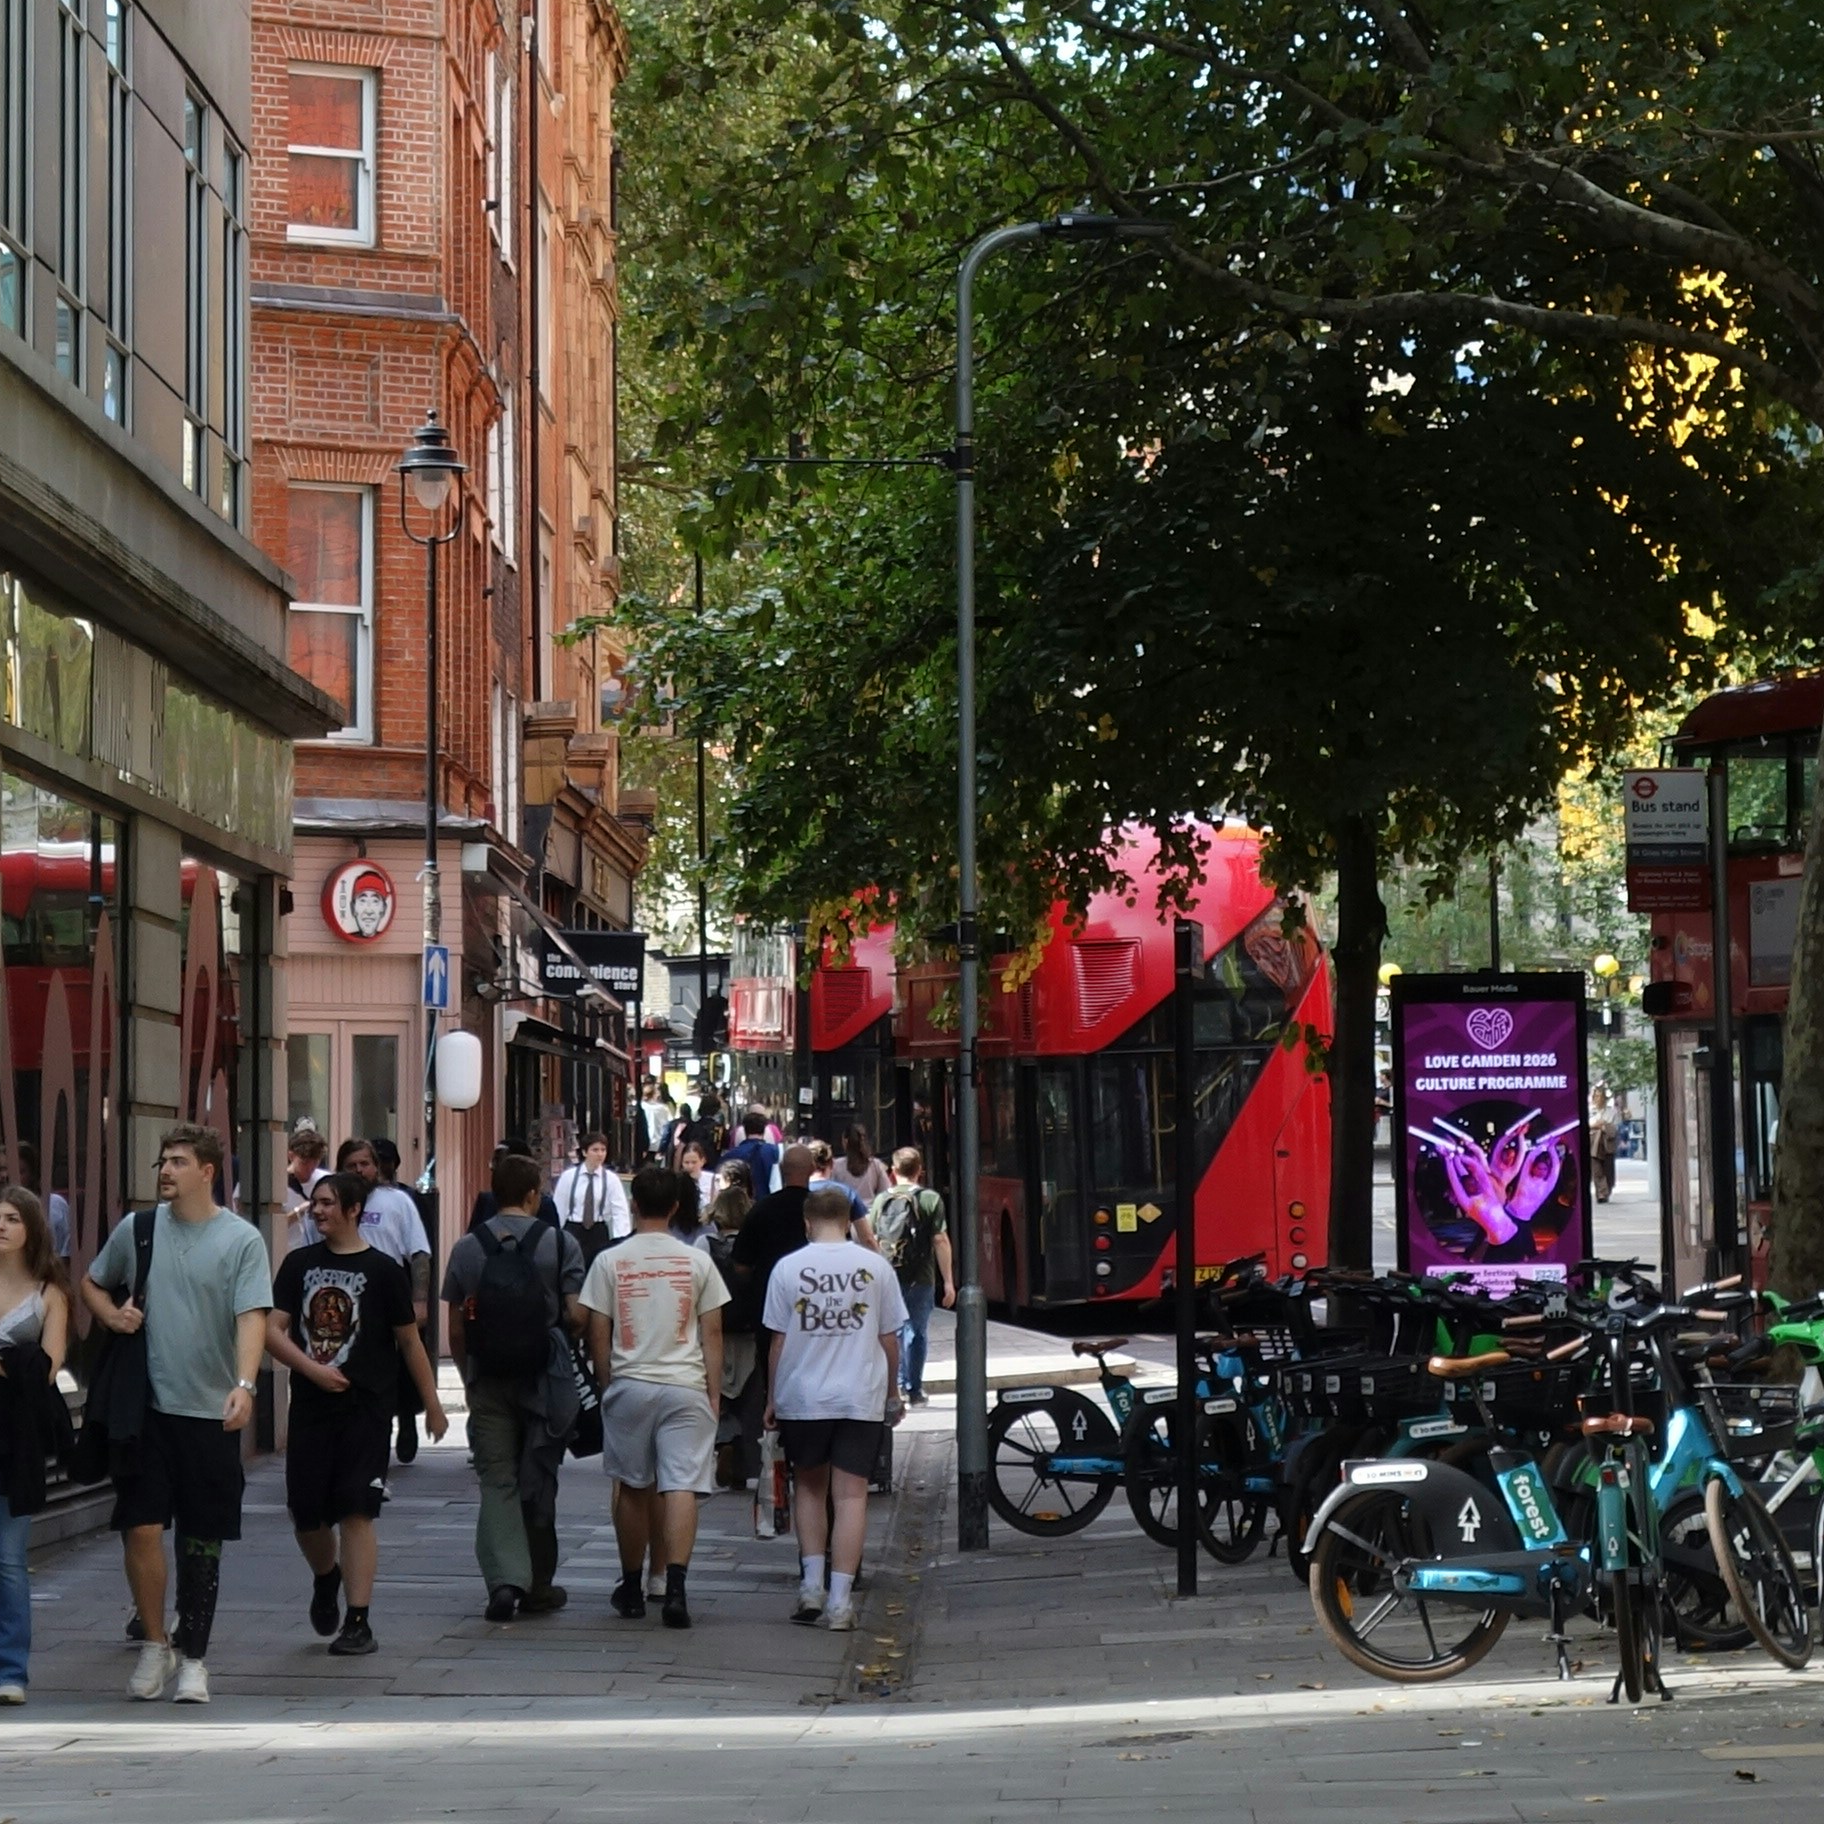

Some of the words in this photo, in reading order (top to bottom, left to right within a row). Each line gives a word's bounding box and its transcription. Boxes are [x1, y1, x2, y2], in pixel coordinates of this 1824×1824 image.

[1632, 801, 1656, 813] Bus
[1662, 800, 1700, 813] stand
[547, 953, 562, 963] the
[546, 964, 638, 981] convnience
[613, 981, 638, 991] store
[1463, 984, 1489, 994] Bauer
[1491, 984, 1518, 993] Media
[1425, 1055, 1459, 1069] LOVE
[1461, 1054, 1521, 1068] CAMDEN
[1523, 1053, 1557, 1067] 2026
[1415, 1077, 1476, 1091] CULTURE
[1478, 1075, 1567, 1090] PROGRAMME
[799, 1266, 867, 1295] Save
[825, 1296, 844, 1307] the
[798, 1299, 865, 1332] Bees
[1513, 1474, 1550, 1539] forest
